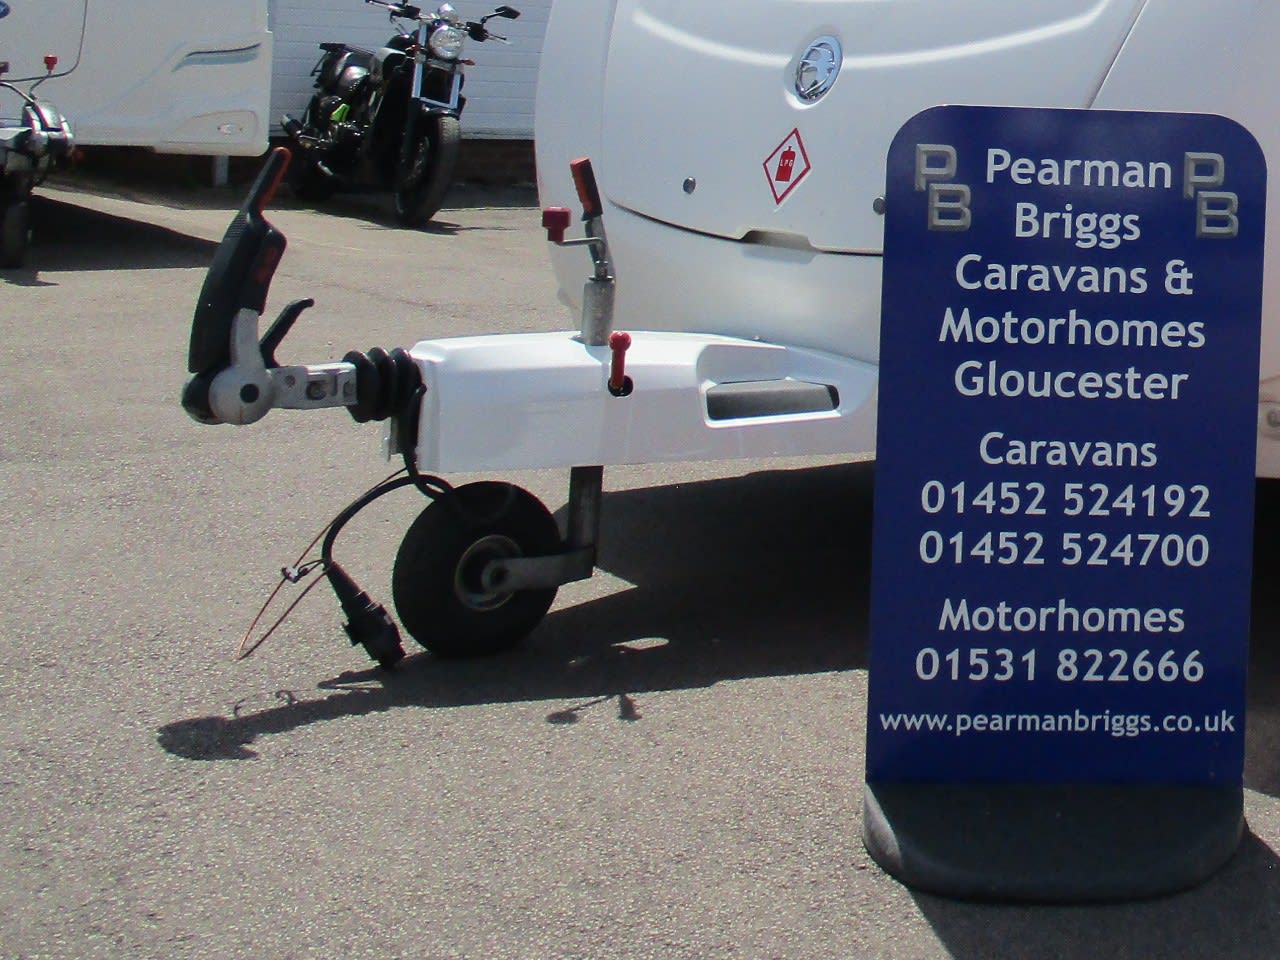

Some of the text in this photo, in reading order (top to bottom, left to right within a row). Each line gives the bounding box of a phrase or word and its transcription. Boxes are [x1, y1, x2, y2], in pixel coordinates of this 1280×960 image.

[986, 148, 1172, 189] Pearman
[1015, 202, 1141, 249] Briggs
[955, 253, 1194, 295] Caravans &
[938, 307, 1206, 348] Motorhomes
[954, 360, 1189, 400] Gloucester
[979, 431, 1158, 468] Caravans
[921, 480, 1211, 518] 01452 524192
[919, 530, 1209, 567] 01452 524700
[938, 598, 1185, 633] Motorhomes
[915, 647, 1204, 682] 01531 822666
[879, 709, 1235, 737] www.pearmanbriggs.co.uk
